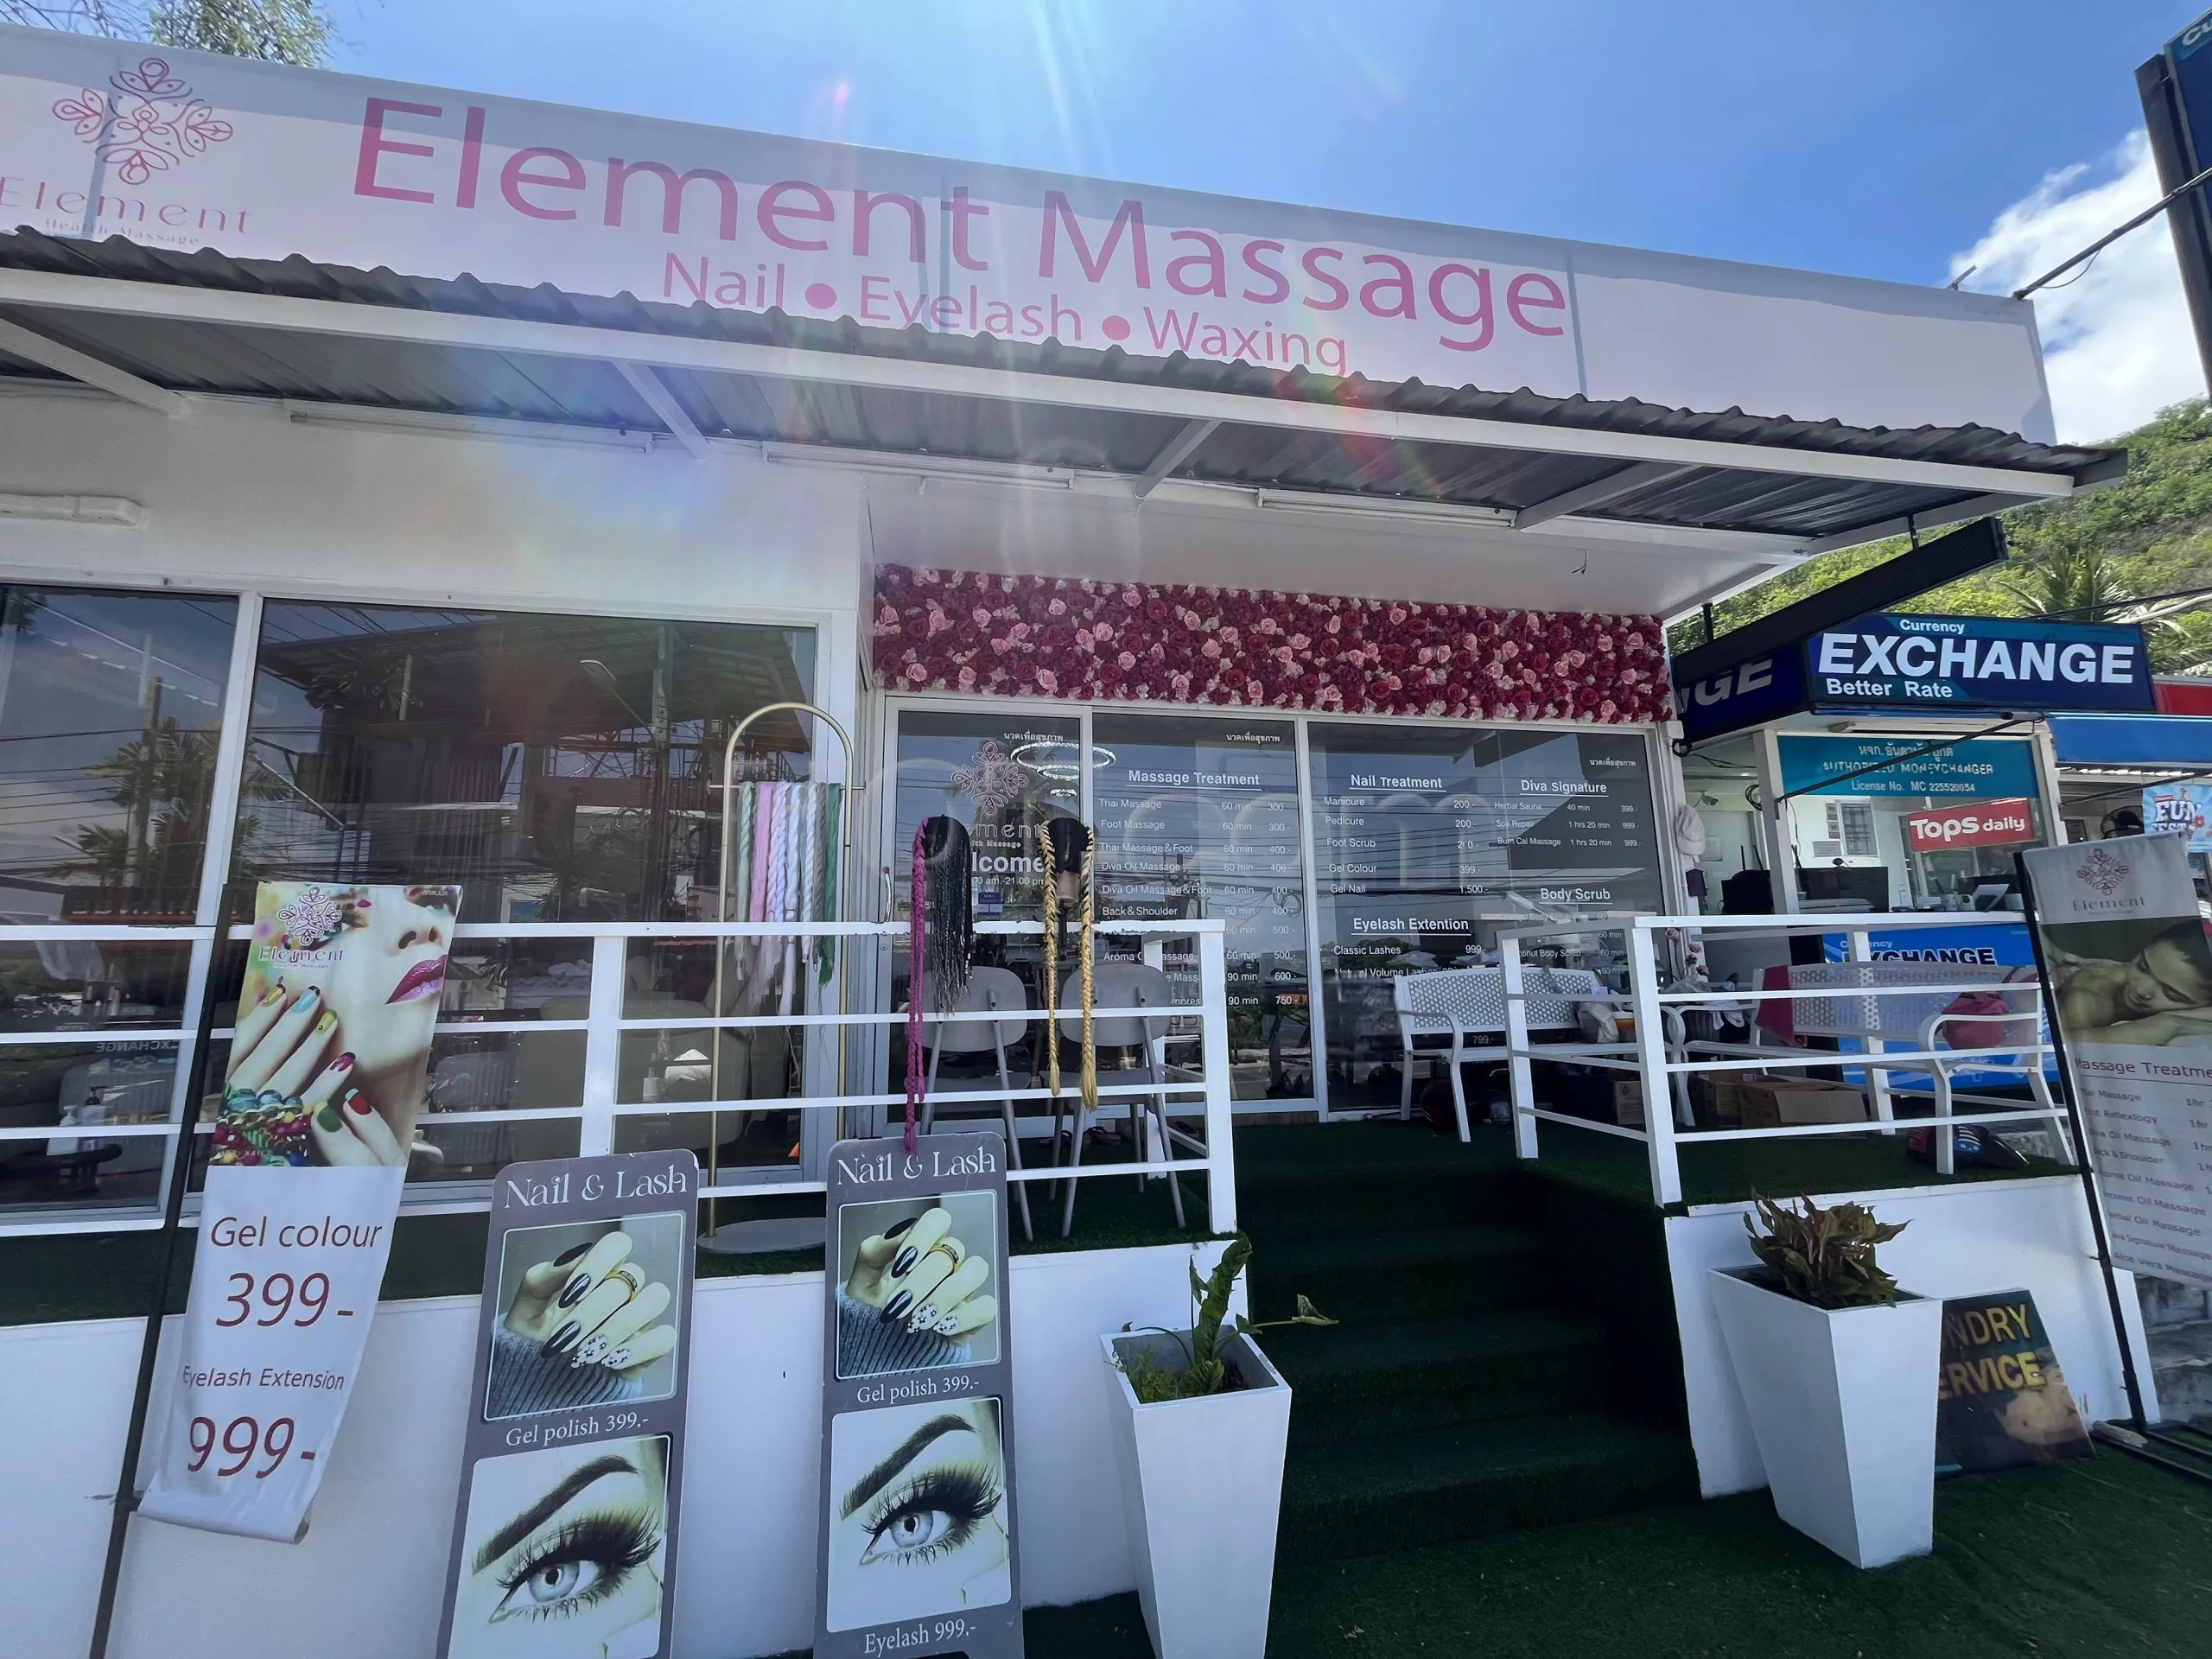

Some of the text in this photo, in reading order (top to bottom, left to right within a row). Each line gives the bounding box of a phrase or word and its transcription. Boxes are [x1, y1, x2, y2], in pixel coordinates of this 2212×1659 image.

[0, 176, 251, 233] Element
[354, 97, 1567, 352] Element Massage
[664, 252, 1346, 375] Nail Eyelash Waxing
[1900, 619, 1965, 635] Currency
[1818, 632, 2133, 683] EXCHANGE
[1826, 677, 1953, 698] Better Rate
[1901, 763, 1993, 774] MONEYCHANGER
[1128, 770, 1260, 785] Massage Treatment
[1351, 774, 1442, 788] Nail Treatment
[1521, 779, 1607, 795] Diva Signature
[1852, 780, 1885, 791] License
[1889, 780, 1904, 791] No.
[1910, 781, 1926, 791] MC
[1099, 798, 1118, 808] Thai
[1121, 799, 1162, 810] Massage
[1222, 802, 1233, 810] 60
[1324, 797, 1365, 806] Manicure
[1494, 802, 1518, 810] Herbal
[1519, 803, 1542, 811] Sauna
[1101, 820, 1122, 829] Foot
[1124, 820, 1166, 831] Massage
[1325, 817, 1364, 826] Pedicure
[1910, 816, 2025, 842] Tops daily
[1099, 842, 1119, 851] Thai
[1123, 842, 1163, 854] Massage
[1164, 843, 1172, 852] &
[1173, 843, 1193, 853] Foot
[1326, 838, 1376, 848] Foot Scrub
[1529, 838, 1561, 847] Massage
[971, 851, 1045, 873] lcome
[1102, 862, 1122, 871] Diva
[1124, 862, 1137, 871] Oil
[1141, 862, 1181, 873] Massage
[1224, 863, 1235, 872] 60
[1329, 864, 1481, 874] Gel Colour 399.-
[1103, 885, 1122, 894] Diva
[1125, 886, 1138, 894] Oil
[1141, 886, 1181, 895] Massage
[1182, 886, 1190, 894] &
[1192, 886, 1211, 894] Foot
[1224, 886, 1236, 894] 60
[1330, 883, 1489, 894] Gel Nail 1,500.-
[1540, 887, 1611, 902] Body Scrub
[1103, 907, 1126, 916] Back
[1127, 907, 1135, 916] &
[1136, 907, 1178, 916] Shoulder
[2073, 897, 2145, 912] Element
[1226, 925, 1237, 934] 60
[1273, 925, 1294, 934] 500.-
[1353, 918, 1469, 932] Eyelash Extention
[258, 945, 344, 962] Element
[1103, 952, 1135, 962] Aroma
[1226, 951, 1237, 960] 60
[1333, 945, 1402, 955] Classic Lashes
[1539, 950, 1559, 958] Body
[1227, 972, 1297, 981] 90 min 600.-
[1369, 967, 1404, 978] Volume
[1228, 996, 1298, 1005] 90 min 750.-
[2075, 1057, 2136, 1075] Massage
[2098, 1090, 2142, 1103] Massage
[2108, 1130, 2172, 1147] Oil Massage
[836, 1146, 997, 1185] Nail & Lash
[504, 1164, 688, 1209] Nail & Lash
[2127, 1173, 2195, 1192] Oil Massage
[2137, 1196, 2152, 1205] Oil
[2154, 1199, 2206, 1217] Massage
[210, 1215, 383, 1248] Gel colour
[2134, 1216, 2202, 1236] Oil Massage
[2166, 1243, 2212, 1261] Massage
[2114, 1251, 2135, 1263] Aloe
[2137, 1257, 2164, 1270] Vera
[215, 1272, 354, 1327] 399-
[1944, 1303, 2031, 1347] NDRY
[182, 1365, 345, 1391] Eyelash Extension
[857, 1375, 980, 1405] Gel polish 399.-
[505, 1412, 649, 1446] Gel polish 399.-
[188, 1415, 316, 1479] 999-
[864, 1618, 976, 1658] Eyelash 999.-
